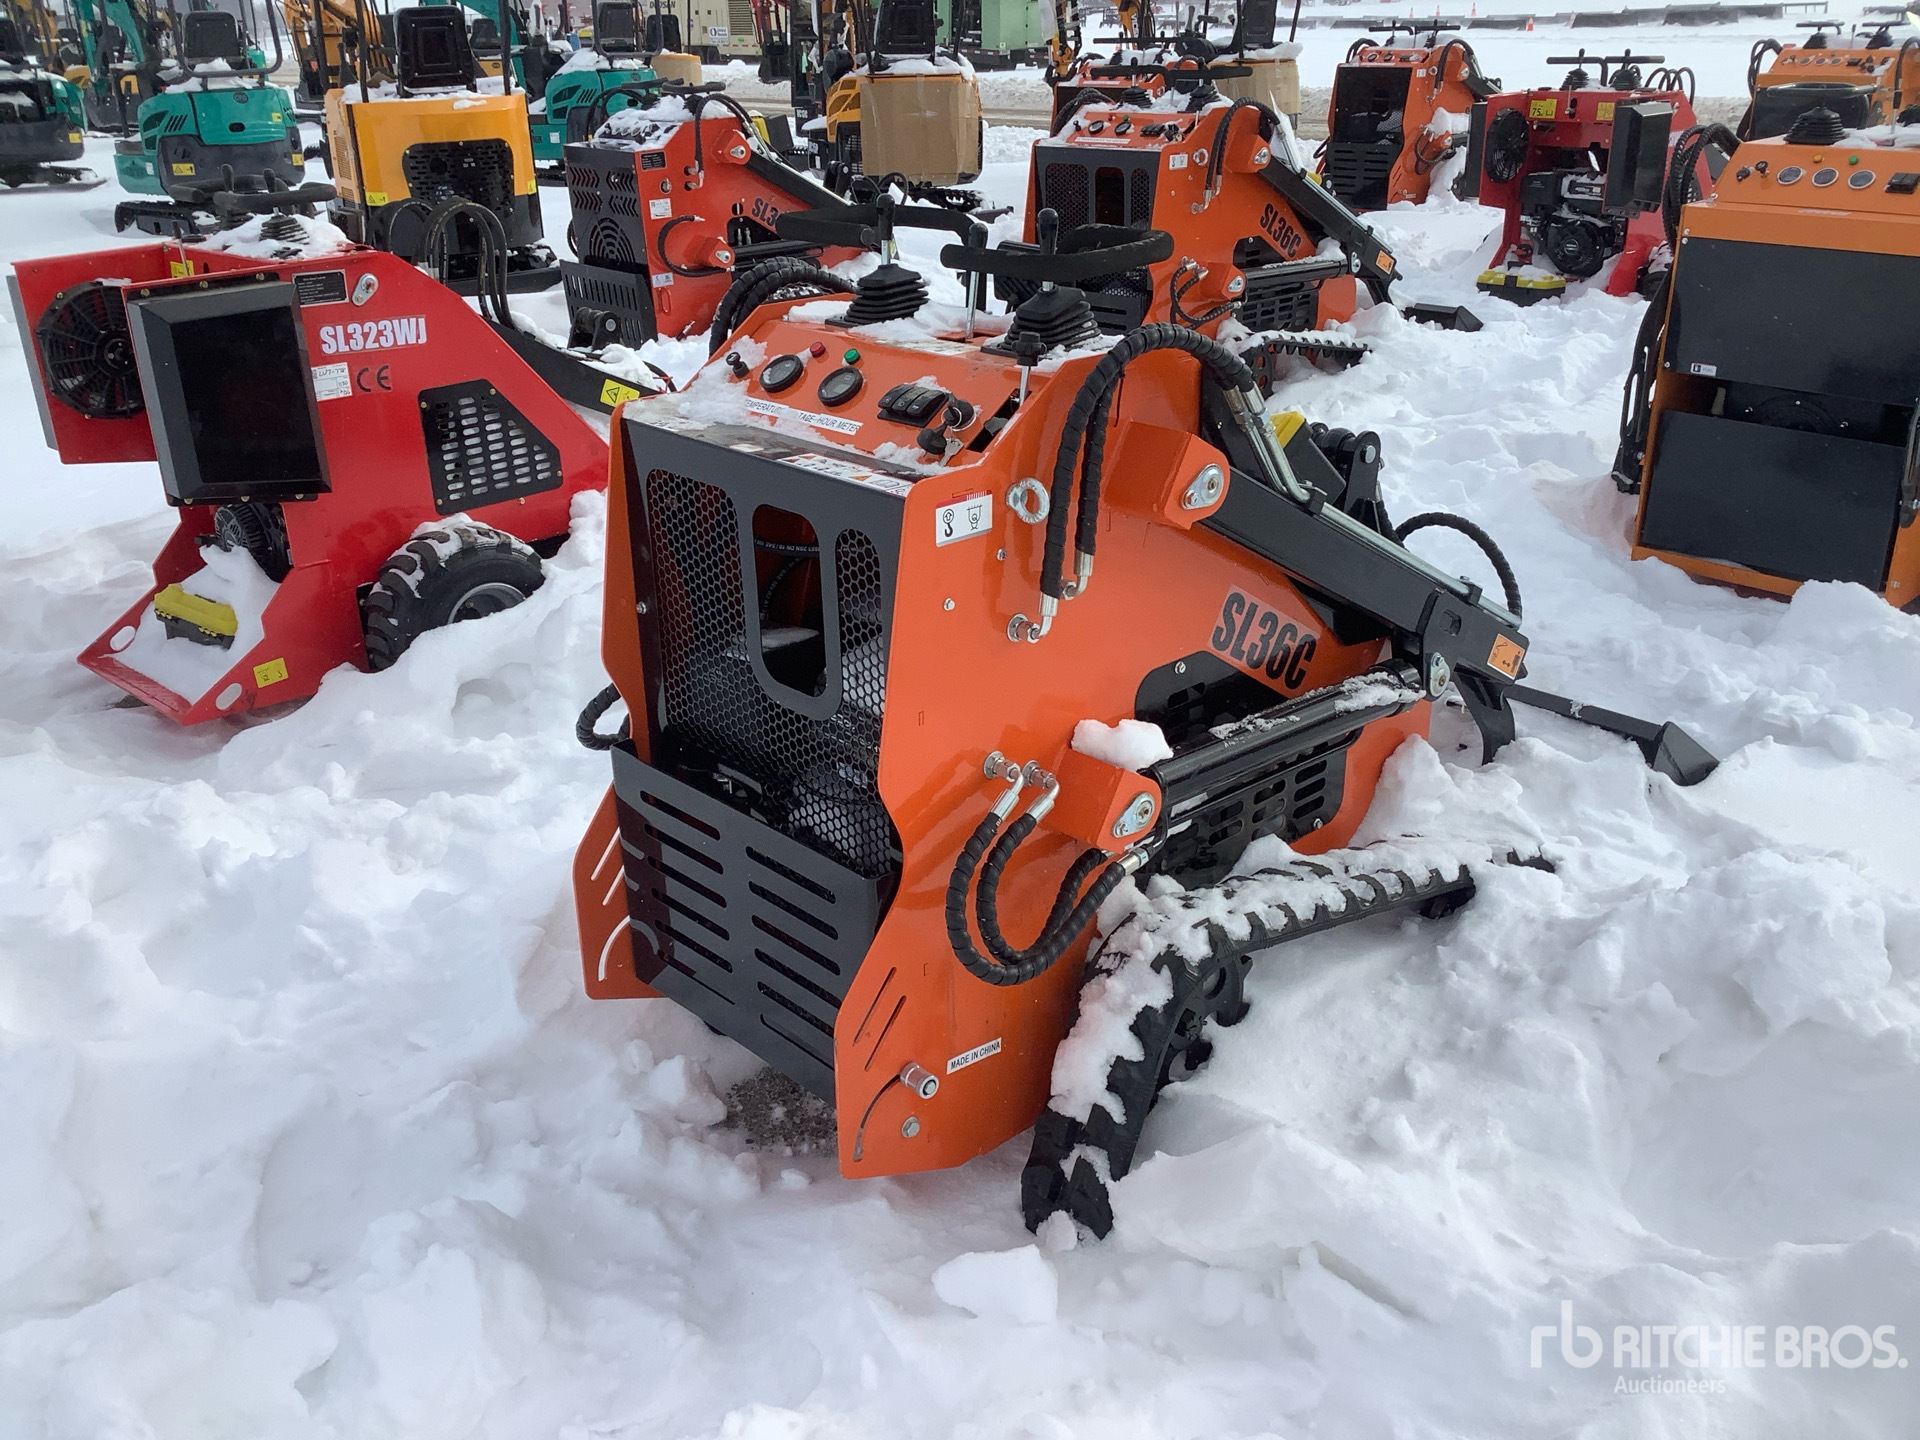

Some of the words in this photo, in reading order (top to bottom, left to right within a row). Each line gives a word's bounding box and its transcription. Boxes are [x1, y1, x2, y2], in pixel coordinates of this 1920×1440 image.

[1260, 202, 1302, 258] SL36C
[319, 317, 427, 354] SL323WJ
[1211, 591, 1317, 690] SL36C
[950, 1054, 970, 1070] MADE
[971, 1050, 979, 1062] IN
[979, 1041, 1001, 1057] CHINA
